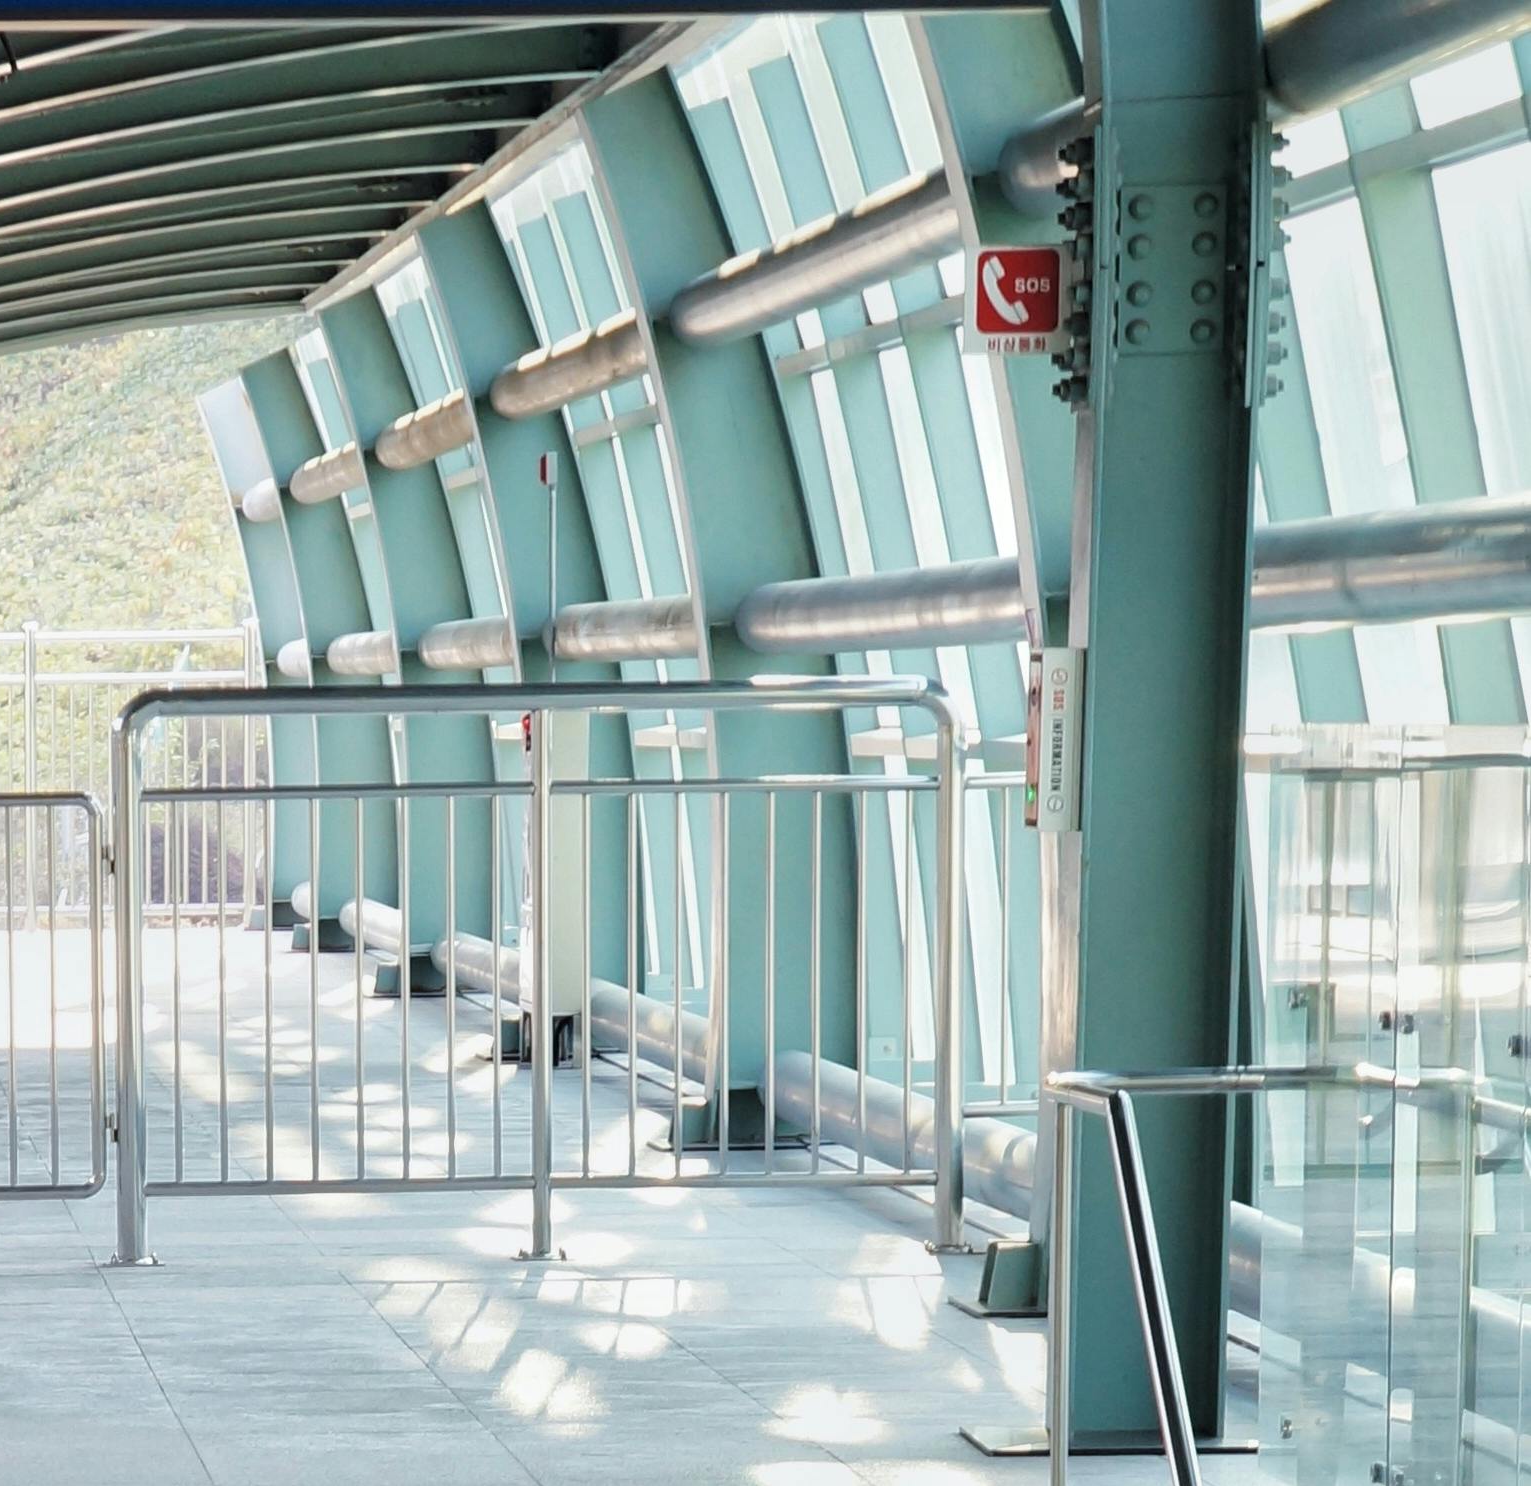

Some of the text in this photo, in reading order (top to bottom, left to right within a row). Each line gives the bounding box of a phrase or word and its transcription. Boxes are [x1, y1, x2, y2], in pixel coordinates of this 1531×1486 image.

[1014, 276, 1051, 293] SOS
[1051, 689, 1064, 791] SOS INFORMATION
